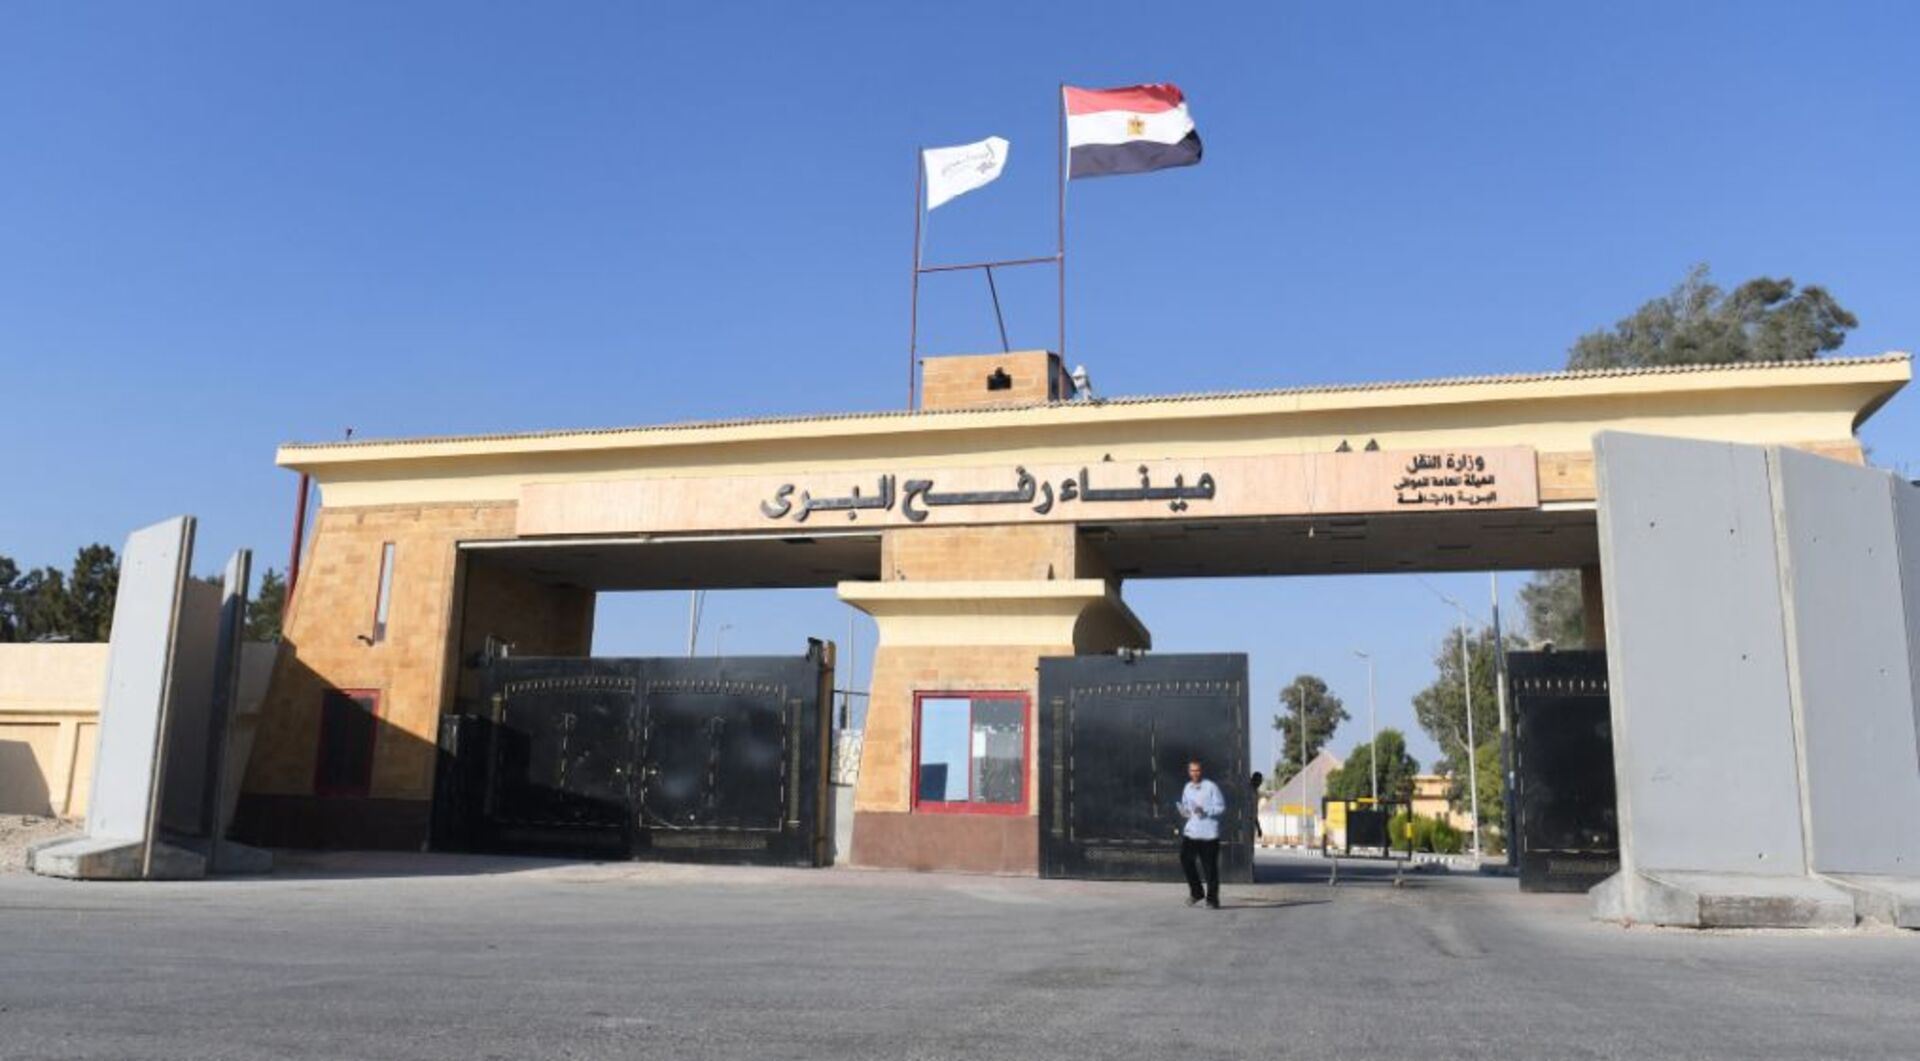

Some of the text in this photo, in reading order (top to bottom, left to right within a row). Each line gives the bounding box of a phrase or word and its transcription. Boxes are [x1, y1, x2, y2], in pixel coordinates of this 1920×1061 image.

[1406, 453, 1485, 474] وزارة النقل
[902, 465, 1055, 523] رفح
[1059, 465, 1216, 512] ميناء
